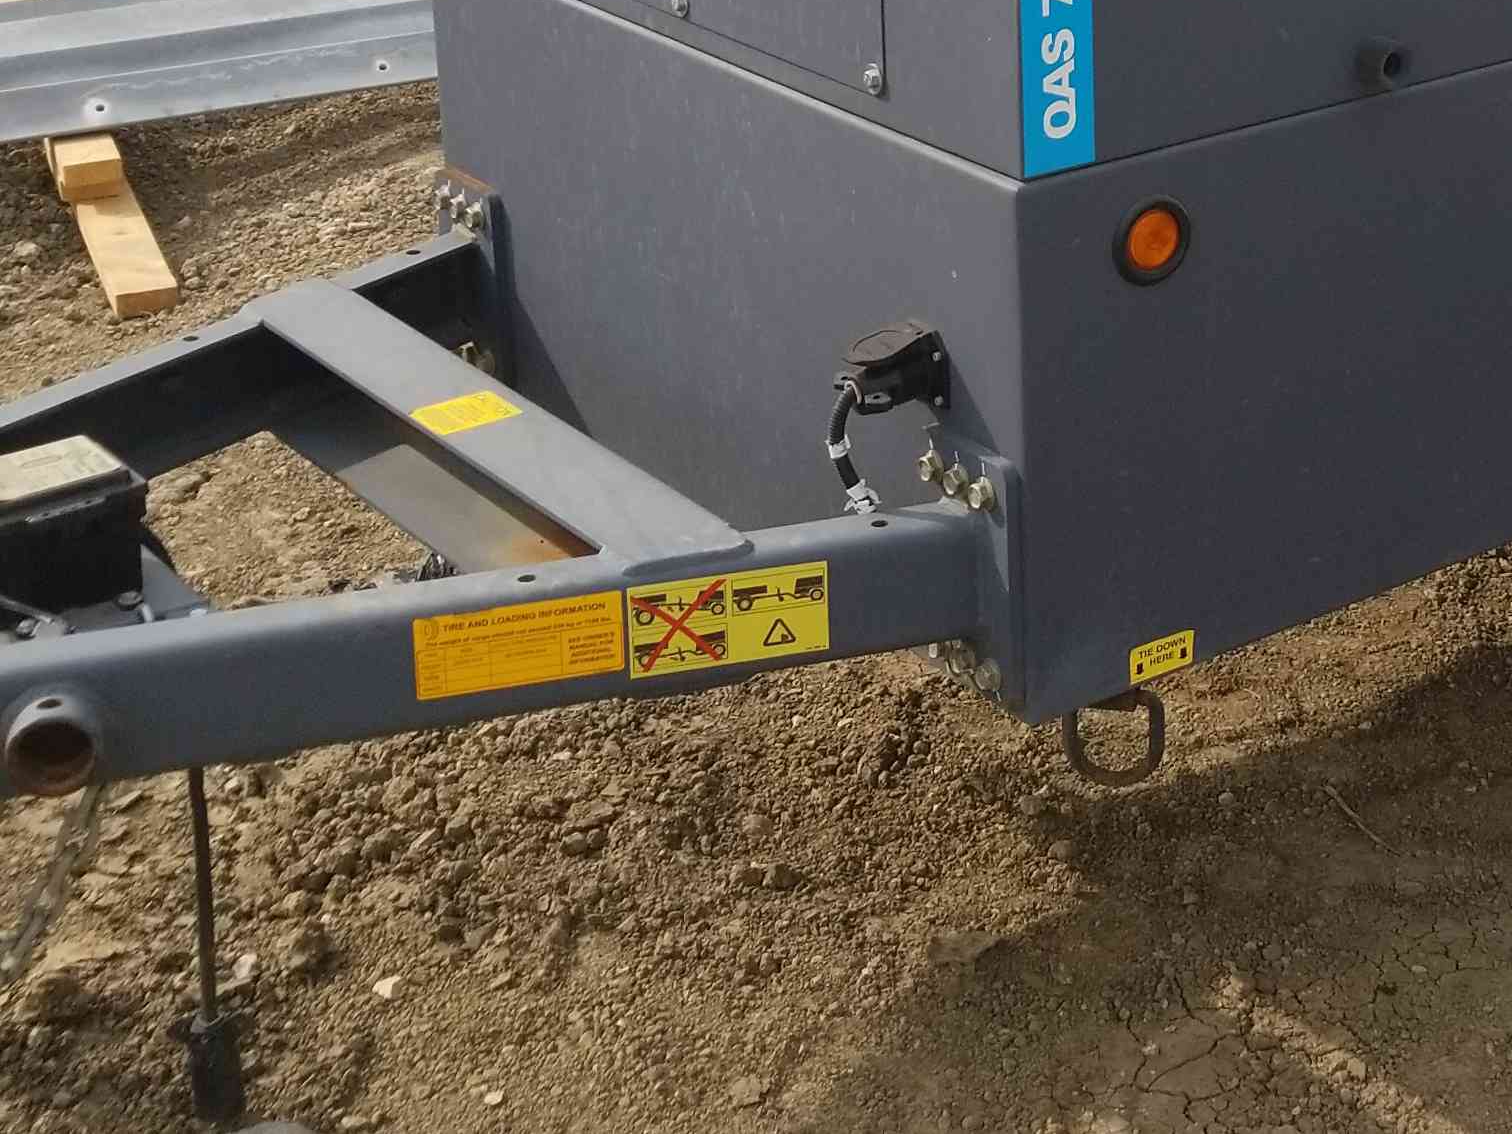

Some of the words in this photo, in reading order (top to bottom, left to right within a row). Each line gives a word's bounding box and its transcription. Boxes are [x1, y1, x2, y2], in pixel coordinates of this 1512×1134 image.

[1041, 28, 1077, 140] QAS
[442, 620, 466, 633] TIRE
[467, 617, 489, 629] AND
[491, 610, 538, 625] LOADING
[538, 601, 607, 619] INFORMATION
[1138, 648, 1154, 659] TIE
[1156, 635, 1187, 653] DOWN
[1149, 651, 1175, 667] HERE
